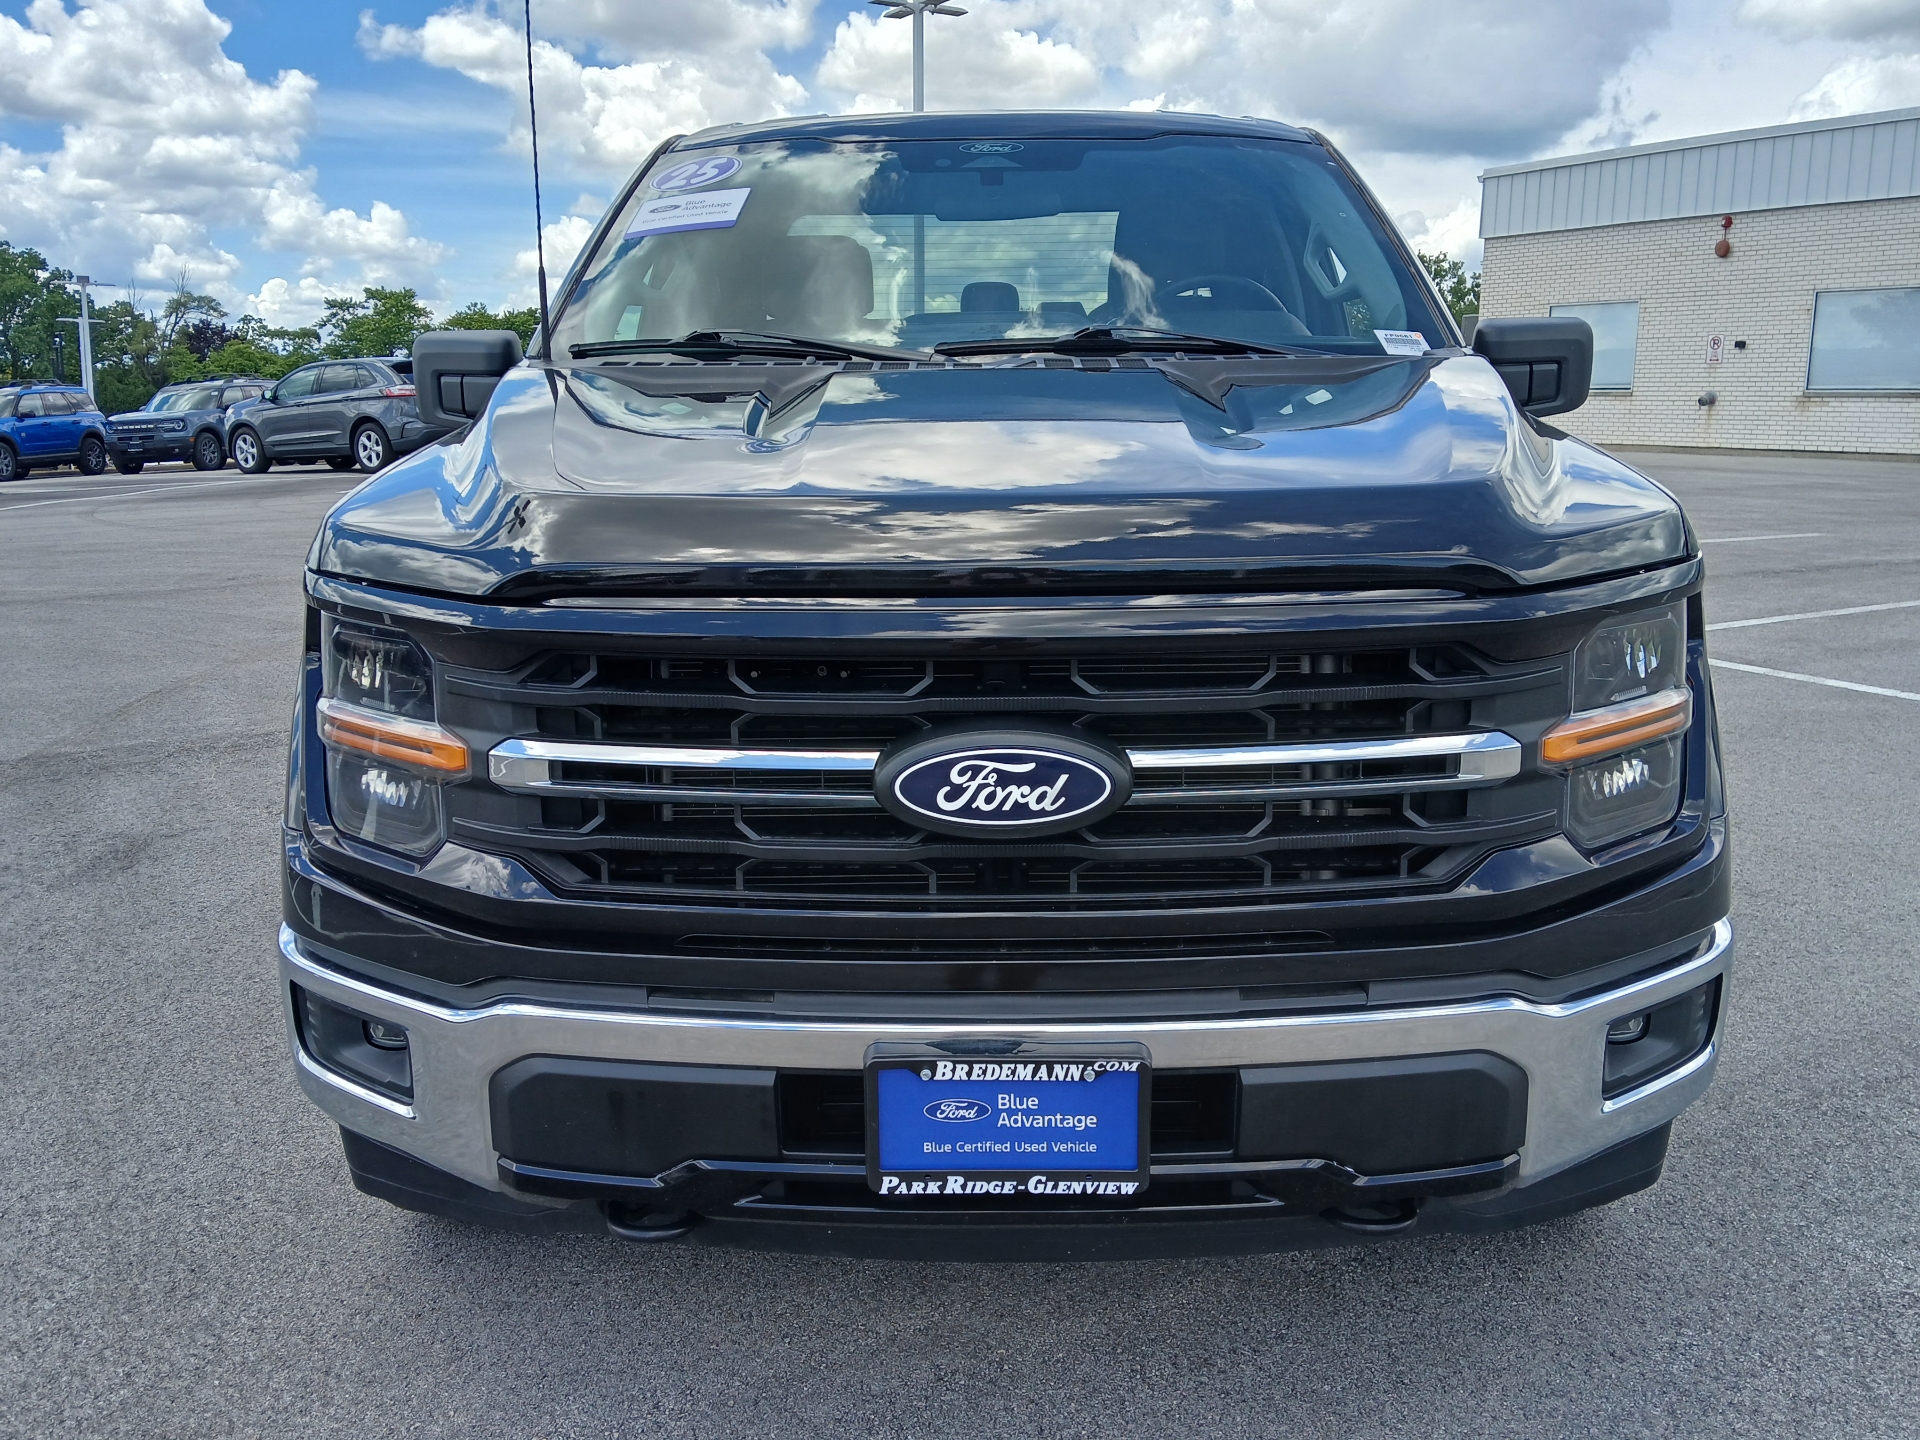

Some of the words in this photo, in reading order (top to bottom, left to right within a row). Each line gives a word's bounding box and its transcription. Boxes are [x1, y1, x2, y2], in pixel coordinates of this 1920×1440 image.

[970, 143, 1013, 153] Ford
[660, 157, 728, 190] 25
[681, 200, 732, 212] Advantage
[936, 759, 1070, 812] Ford
[936, 1101, 979, 1119] Ford
[997, 1093, 1039, 1110] Blue
[997, 1111, 1098, 1131] Advantage
[923, 1141, 953, 1153] Blue
[955, 1141, 1011, 1153] Certified
[1014, 1141, 1048, 1153] Used
[1051, 1141, 1098, 1153] Vehicle
[878, 1175, 943, 1196] PARK
[943, 1174, 1140, 1196] RIDGE-GLENVIEW
